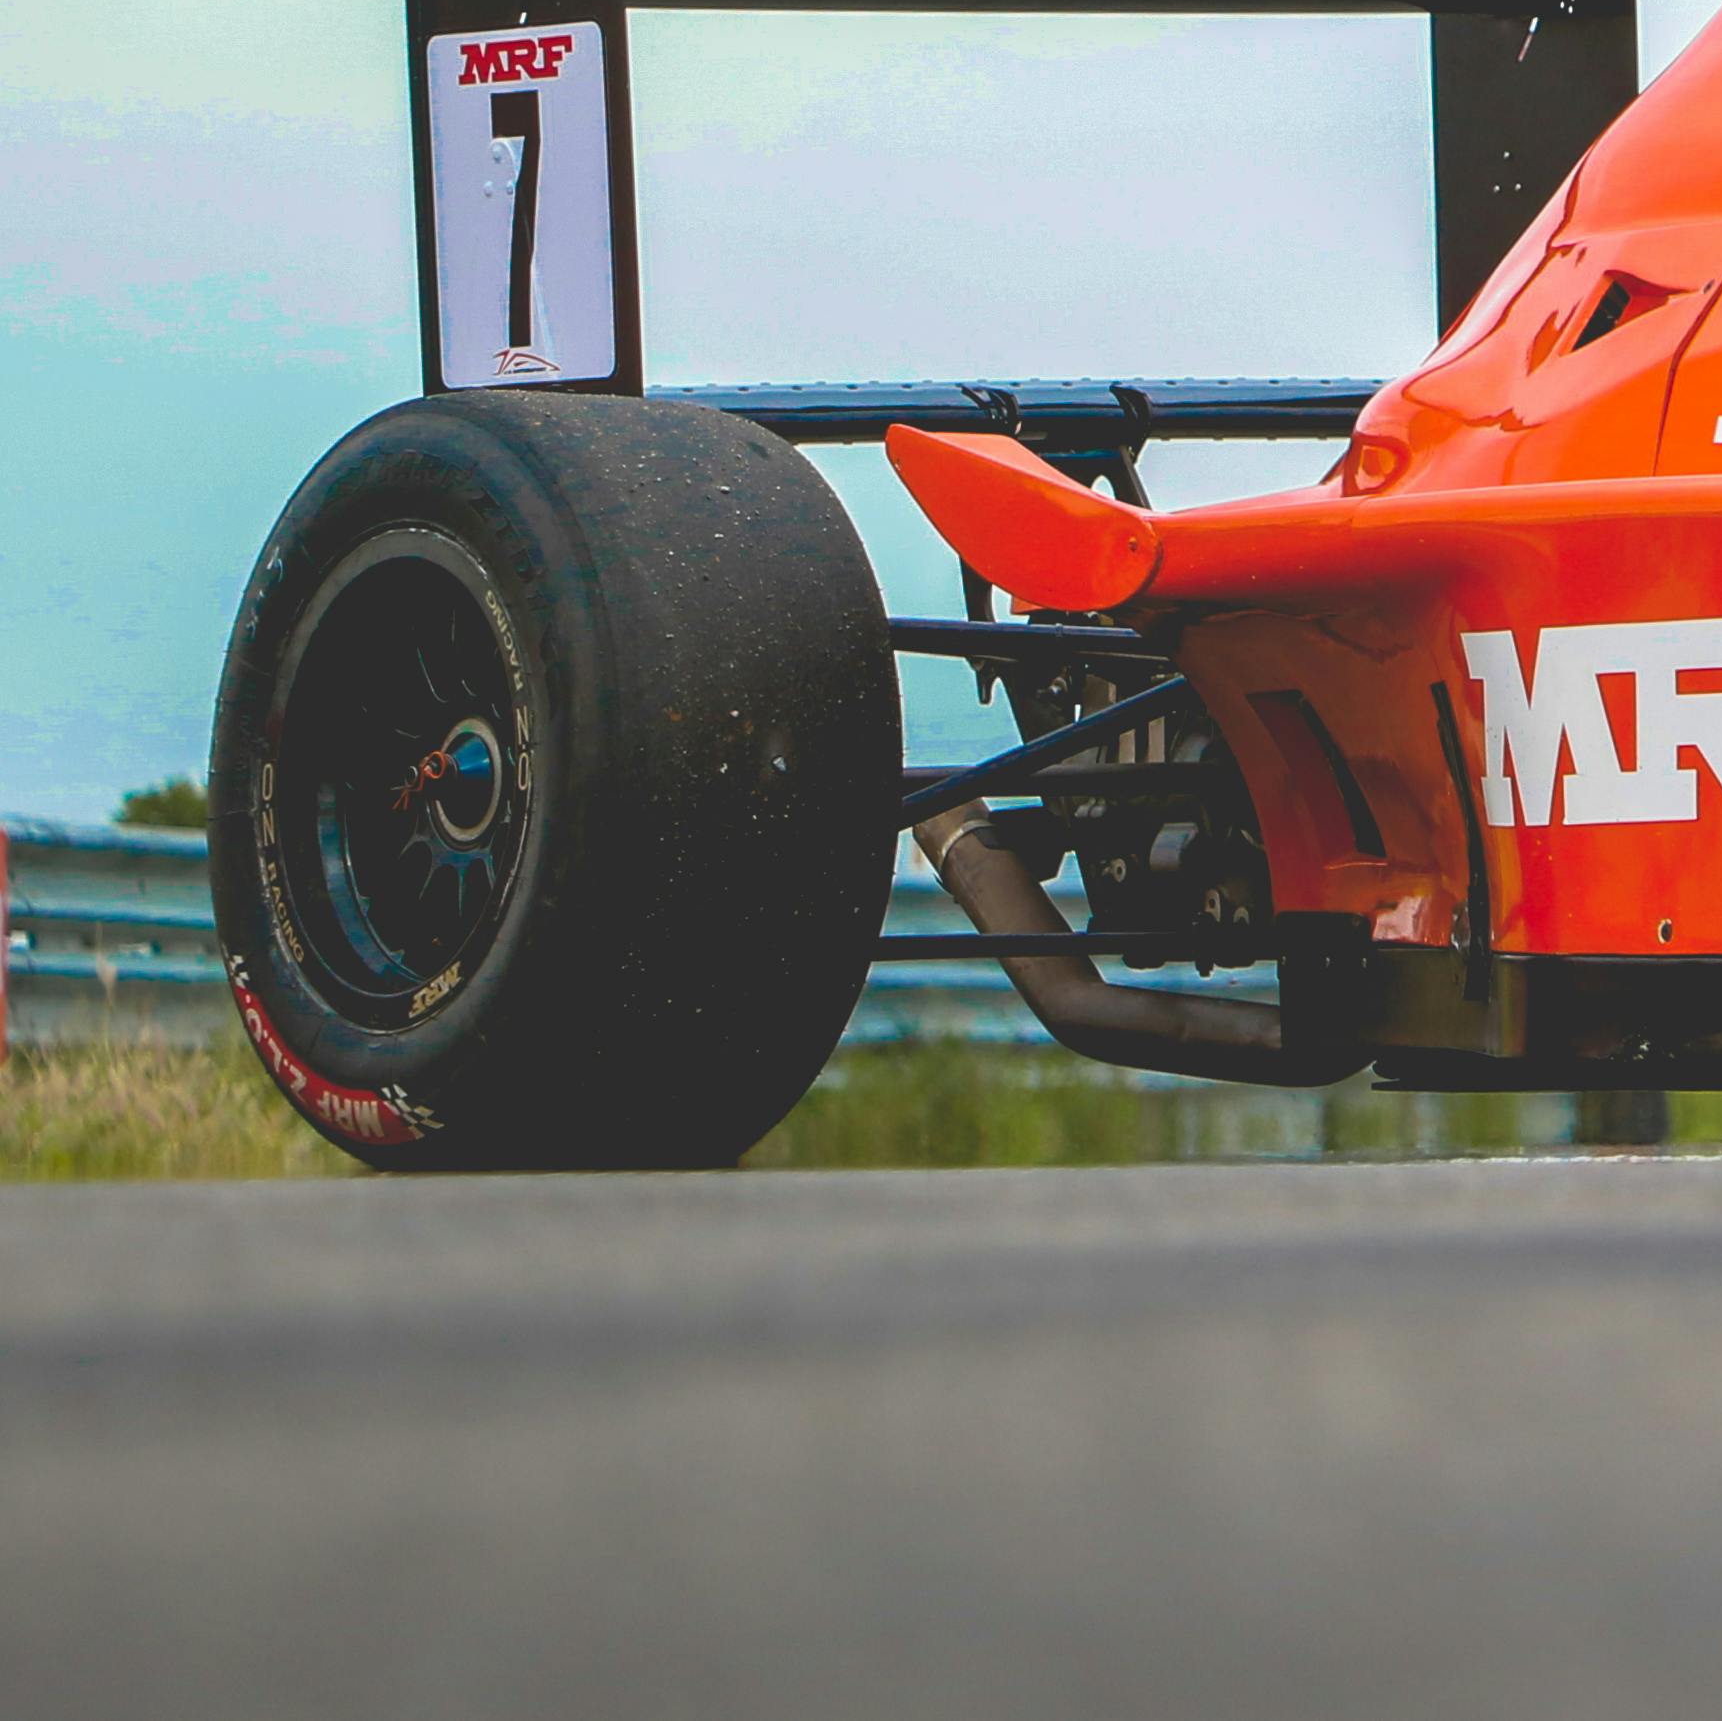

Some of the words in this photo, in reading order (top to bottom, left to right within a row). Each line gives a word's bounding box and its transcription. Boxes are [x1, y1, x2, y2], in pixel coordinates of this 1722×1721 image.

[458, 35, 573, 86] MRF
[490, 88, 542, 349] 7
[485, 588, 524, 691] RACING
[267, 861, 305, 963] RACING
[408, 960, 463, 1019] MRF
[244, 993, 308, 1104] Z.L.O.
[316, 1090, 385, 1139] MRF
